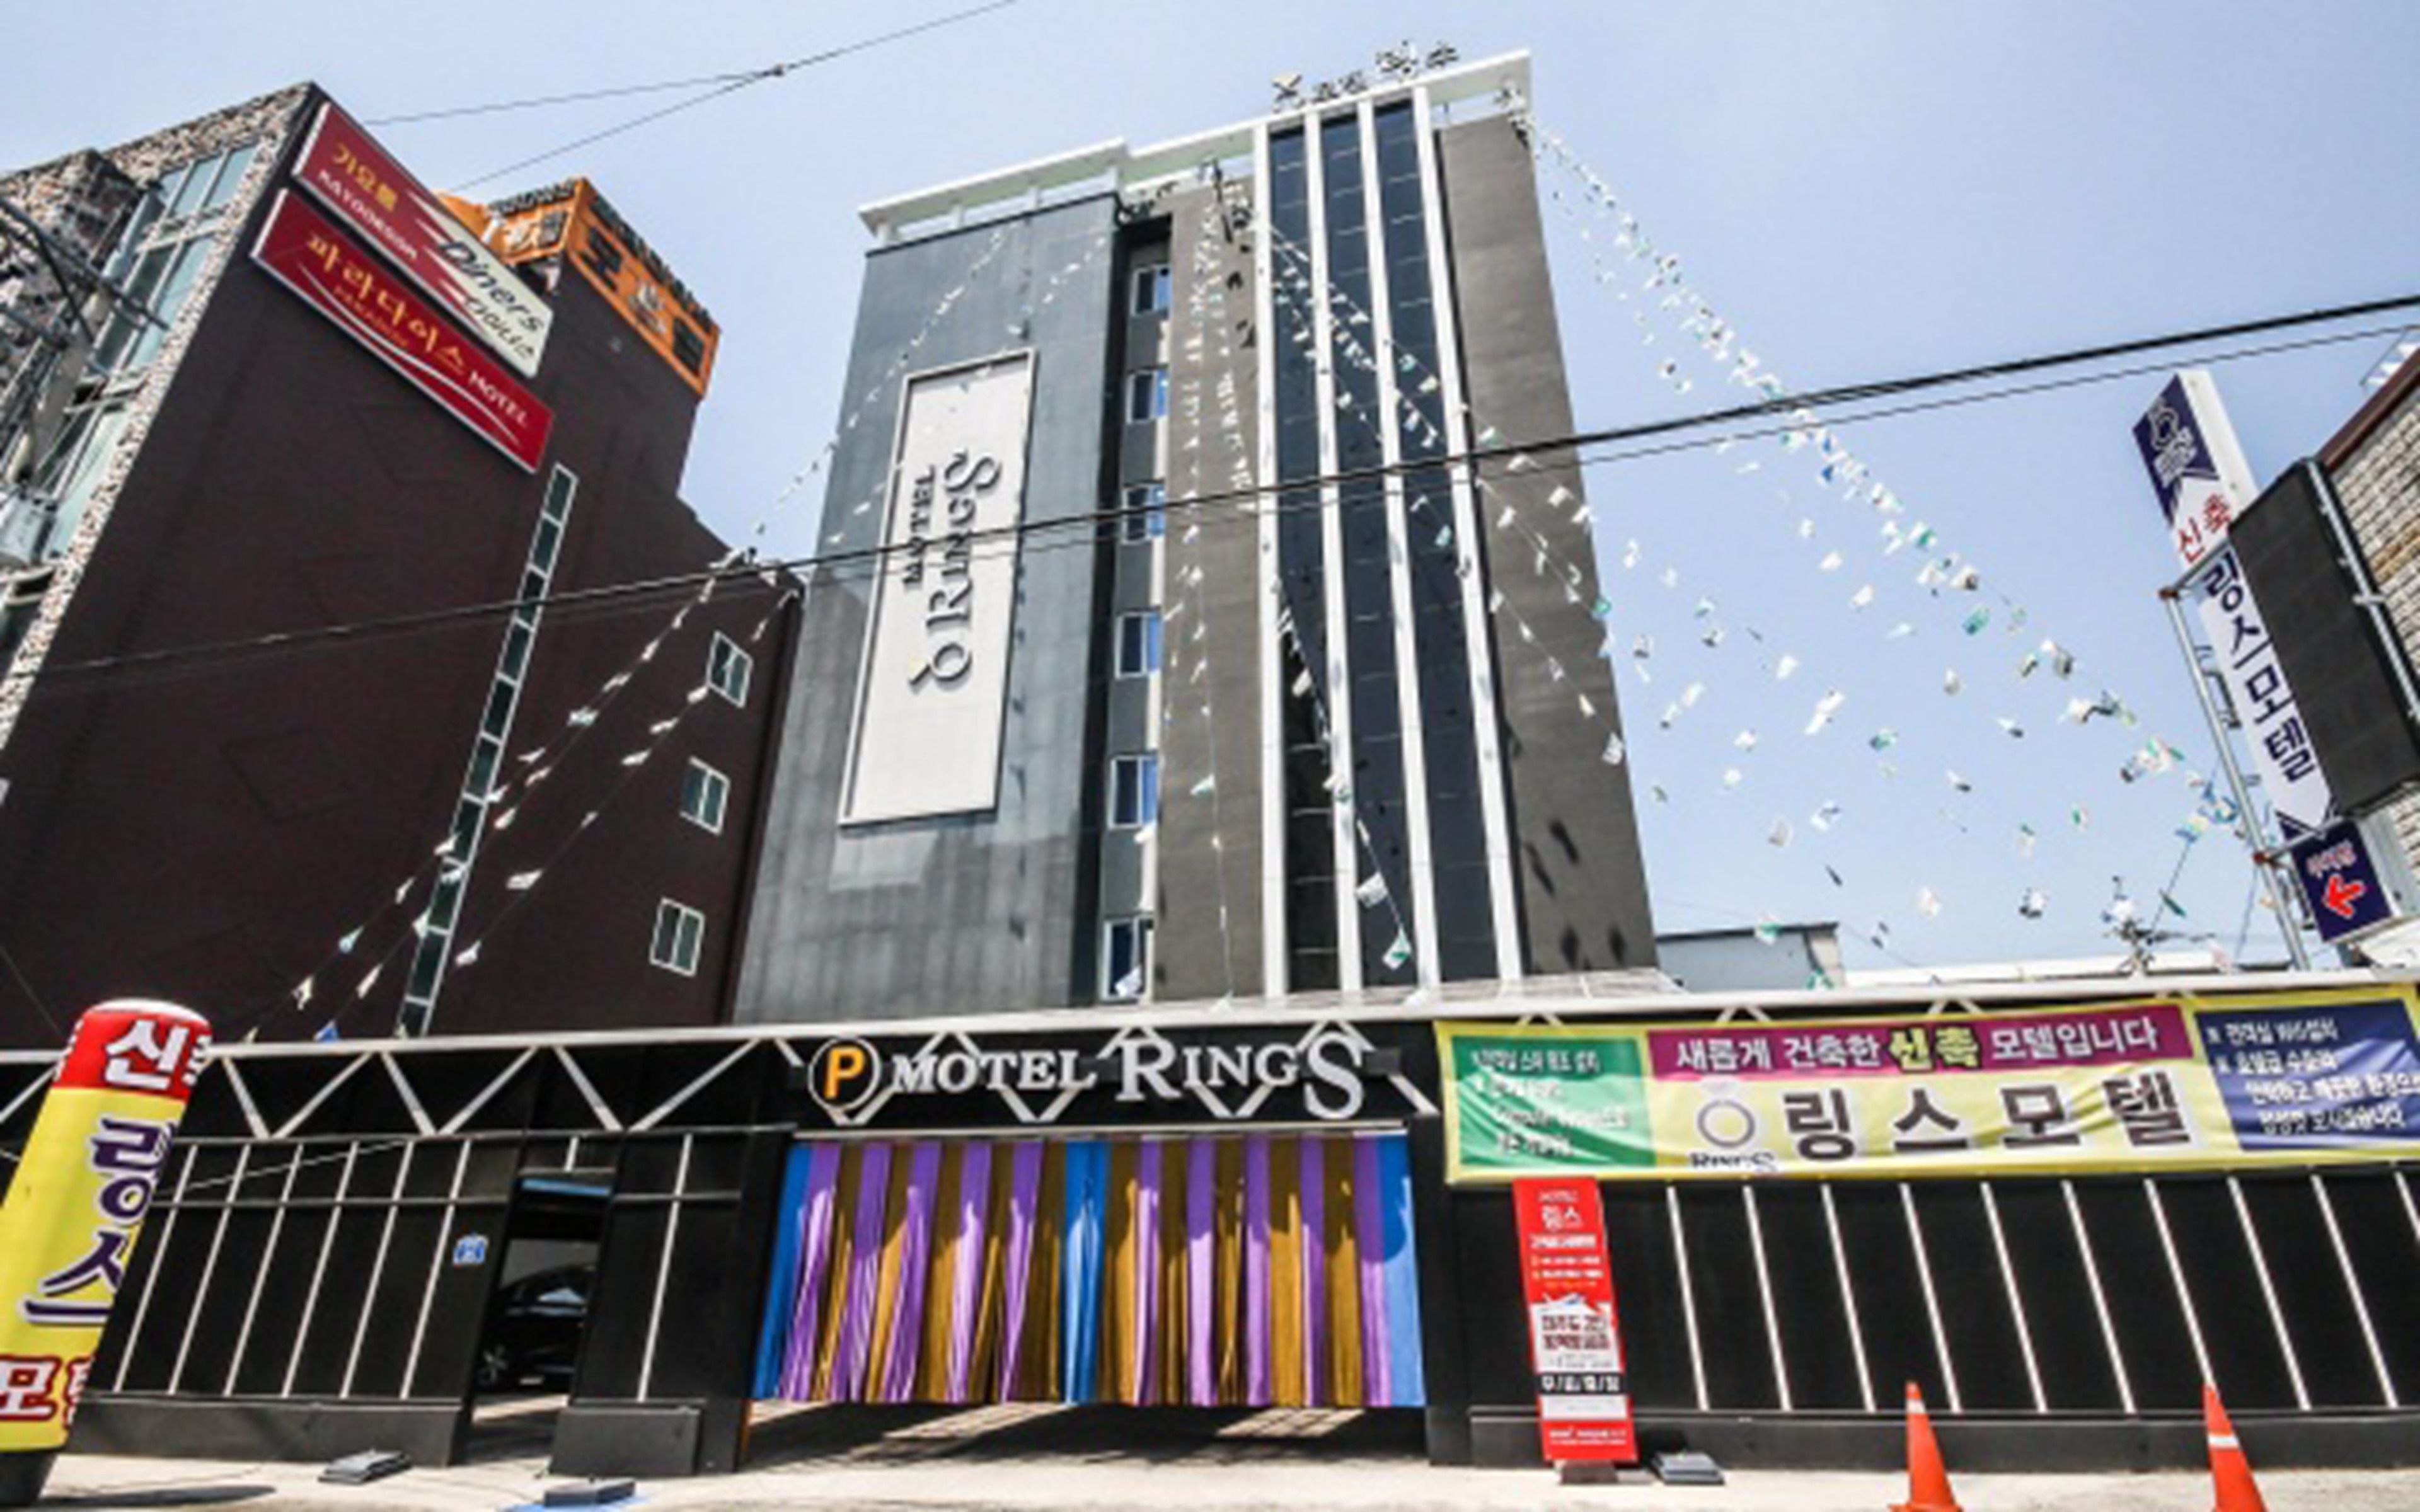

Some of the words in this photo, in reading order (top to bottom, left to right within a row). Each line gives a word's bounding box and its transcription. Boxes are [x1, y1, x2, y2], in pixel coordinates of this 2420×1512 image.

[440, 241, 546, 334] Diners
[902, 465, 936, 587] MOTEL
[925, 449, 1003, 631] RINGS
[824, 1046, 865, 1099] P
[890, 1046, 1098, 1095] MOTEL
[1114, 1031, 1365, 1120] RINGS
[1676, 1038, 1772, 1070] 새롭게
[1783, 1034, 1881, 1068] 건축한
[1889, 1027, 1980, 1070] 신축
[1990, 1017, 2158, 1060] 모텔입니다
